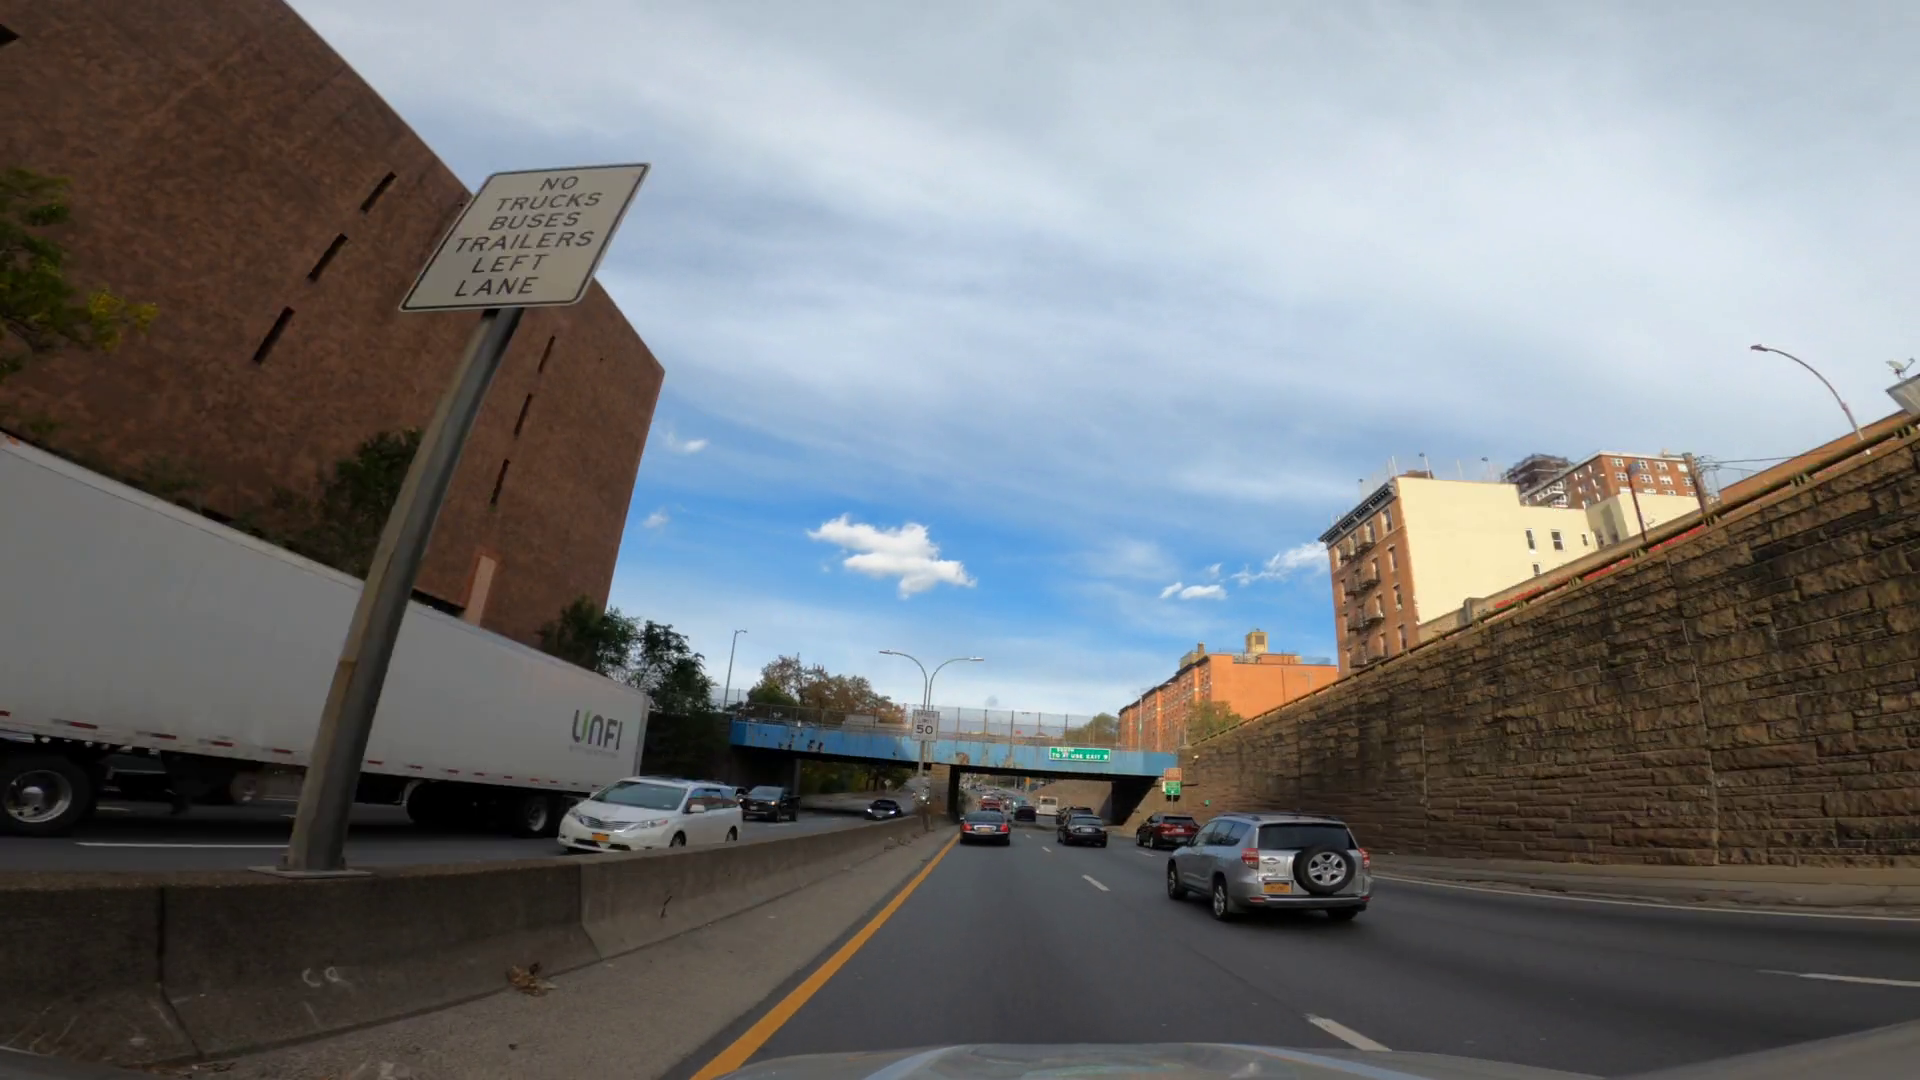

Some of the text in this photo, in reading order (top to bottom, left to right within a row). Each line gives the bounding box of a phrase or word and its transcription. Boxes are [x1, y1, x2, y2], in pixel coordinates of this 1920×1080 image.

[539, 176, 579, 191] NO
[496, 191, 602, 212] TRUCKS
[488, 211, 582, 231] BUSES
[455, 230, 595, 253] TRAILERS
[471, 253, 549, 274] LEFT
[454, 276, 539, 297] LANE
[571, 709, 623, 750] UNFI
[916, 724, 933, 735] 50
